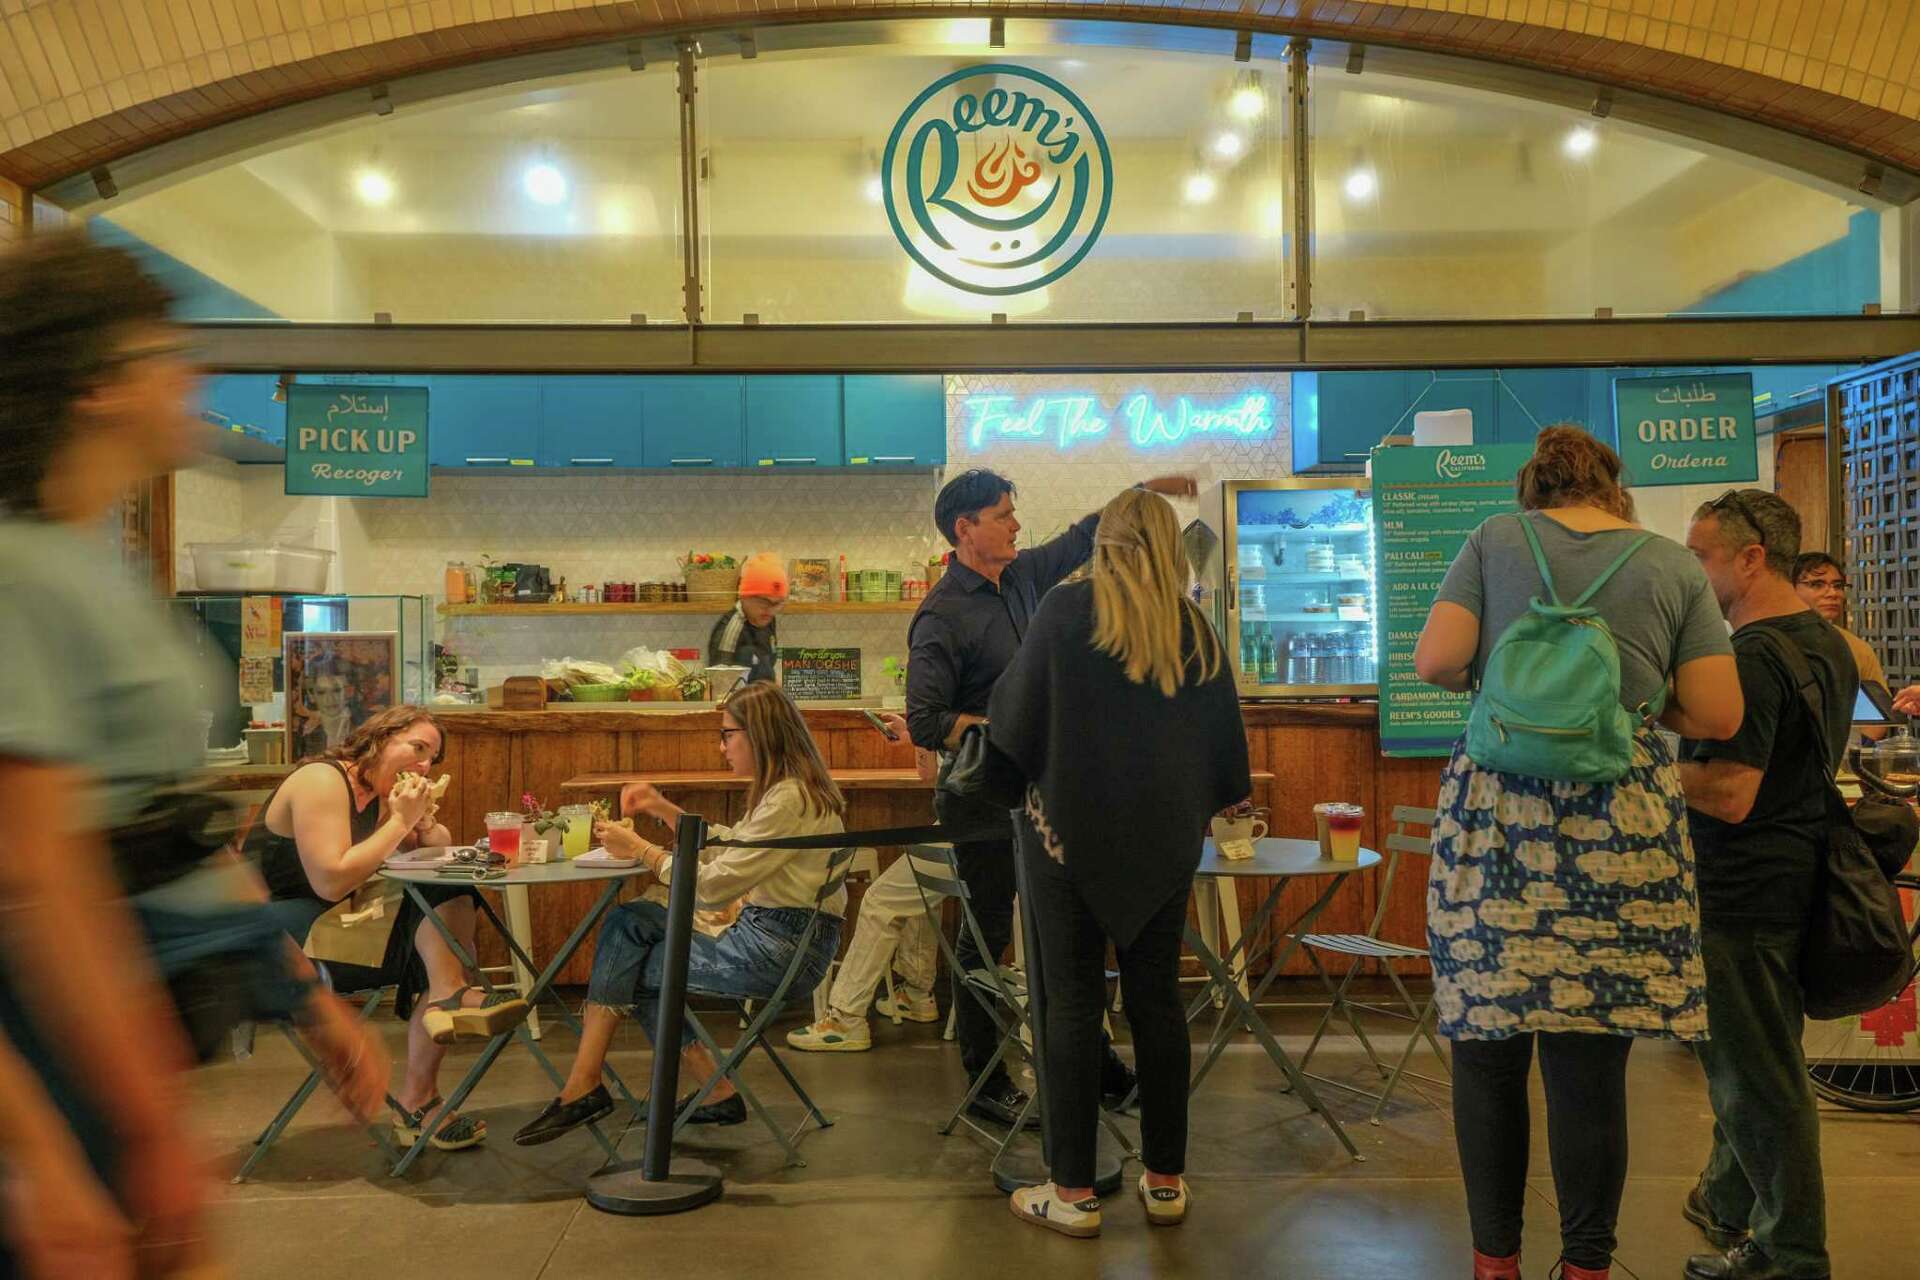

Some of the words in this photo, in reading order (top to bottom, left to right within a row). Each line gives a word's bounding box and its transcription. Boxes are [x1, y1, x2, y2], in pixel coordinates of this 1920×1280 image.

[1655, 382, 1717, 408] طلبات
[965, 396, 1046, 447] Feel
[1046, 397, 1107, 448] The
[1126, 392, 1272, 444] Warmth
[1638, 416, 1738, 443] ORDER
[298, 427, 369, 453] PICK
[377, 429, 417, 453] UP
[1436, 449, 1486, 478] Reem's
[1651, 452, 1728, 470] Ordena
[311, 463, 403, 486] Recoger
[1382, 492, 1416, 501] CLASSIC
[1384, 521, 1404, 529] MLM
[1405, 551, 1424, 560] CALI
[1392, 583, 1409, 592] ADD
[1430, 582, 1442, 590] CA
[1388, 631, 1418, 641] DAMAS
[1388, 652, 1416, 661] HIBIS
[1388, 672, 1421, 681] SUNRIS
[1390, 691, 1440, 702] CARDAMOM
[1441, 691, 1464, 701] COLD
[1389, 711, 1422, 721] REEM'S
[1423, 710, 1462, 720] GOODIES
